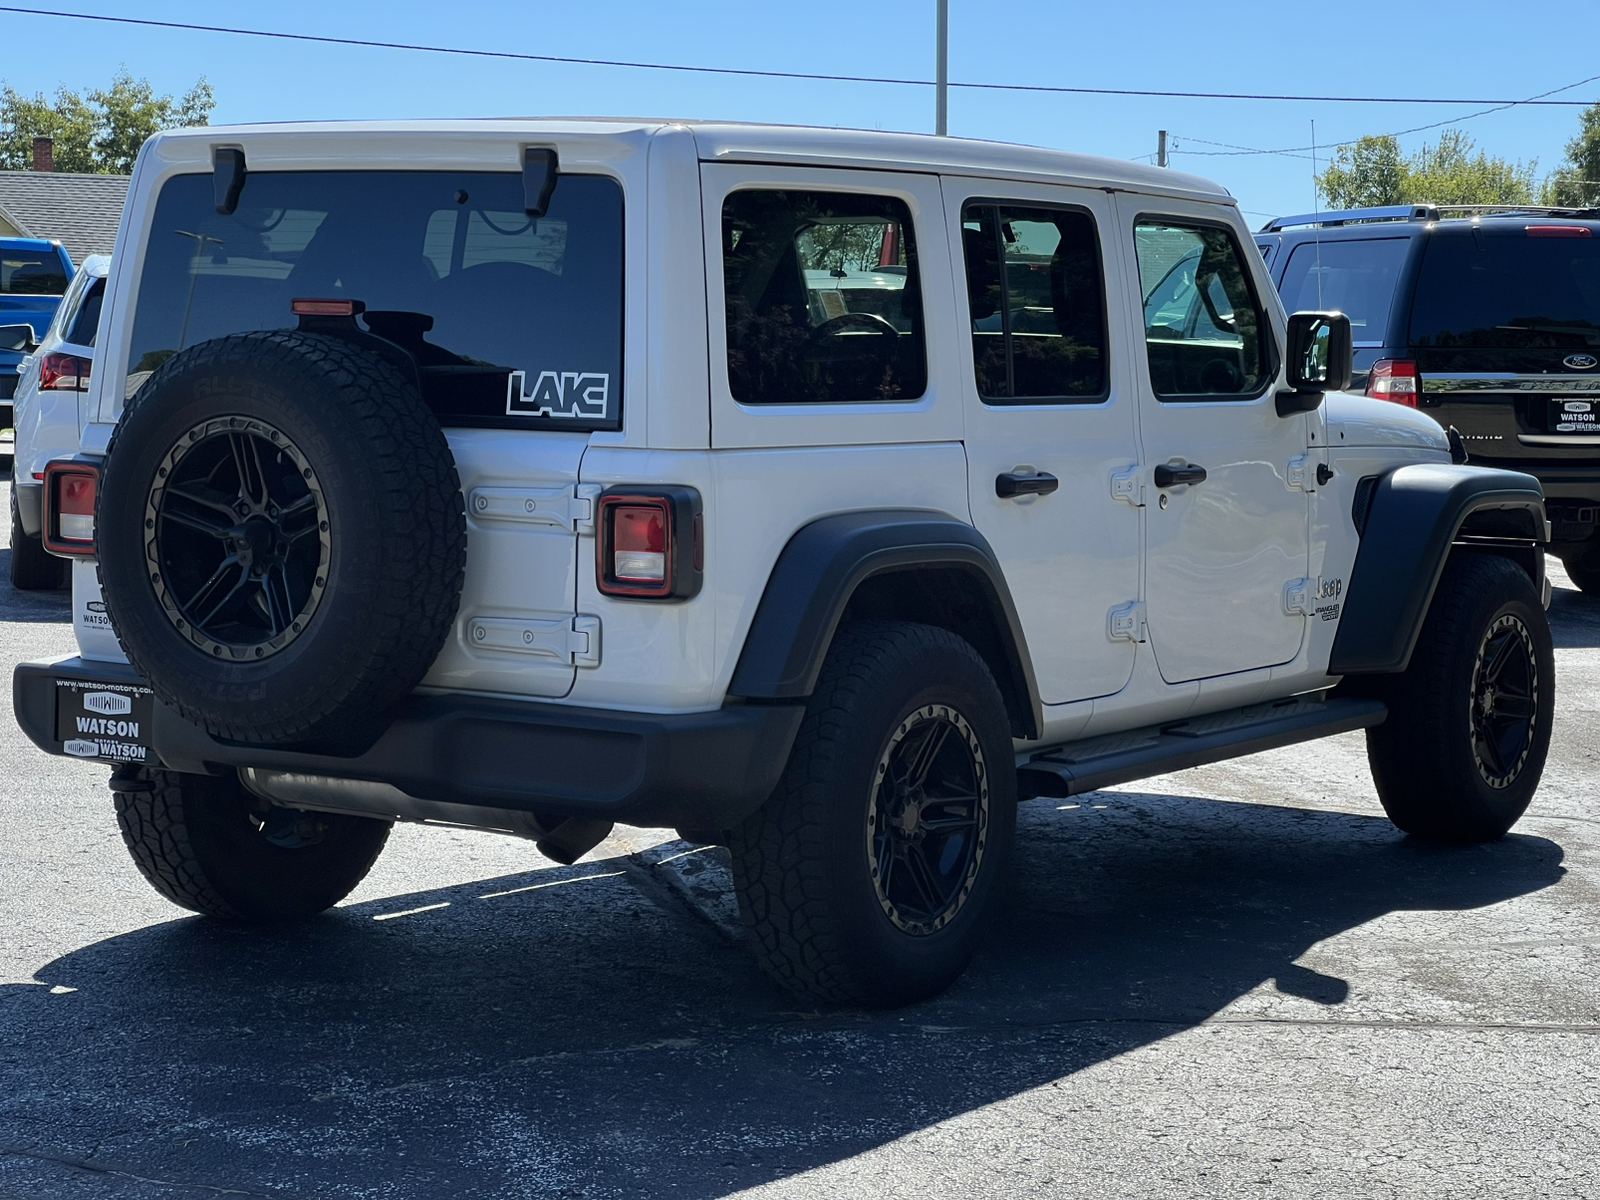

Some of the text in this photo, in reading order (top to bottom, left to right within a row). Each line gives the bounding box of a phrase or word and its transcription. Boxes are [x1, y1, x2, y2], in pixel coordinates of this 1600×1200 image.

[1571, 356, 1591, 366] Ford
[506, 370, 609, 418] LAKE
[1560, 413, 1595, 421] WATSON
[1315, 575, 1341, 601] Jeep
[76, 716, 139, 738] WATSON
[100, 743, 146, 758] WATSON
